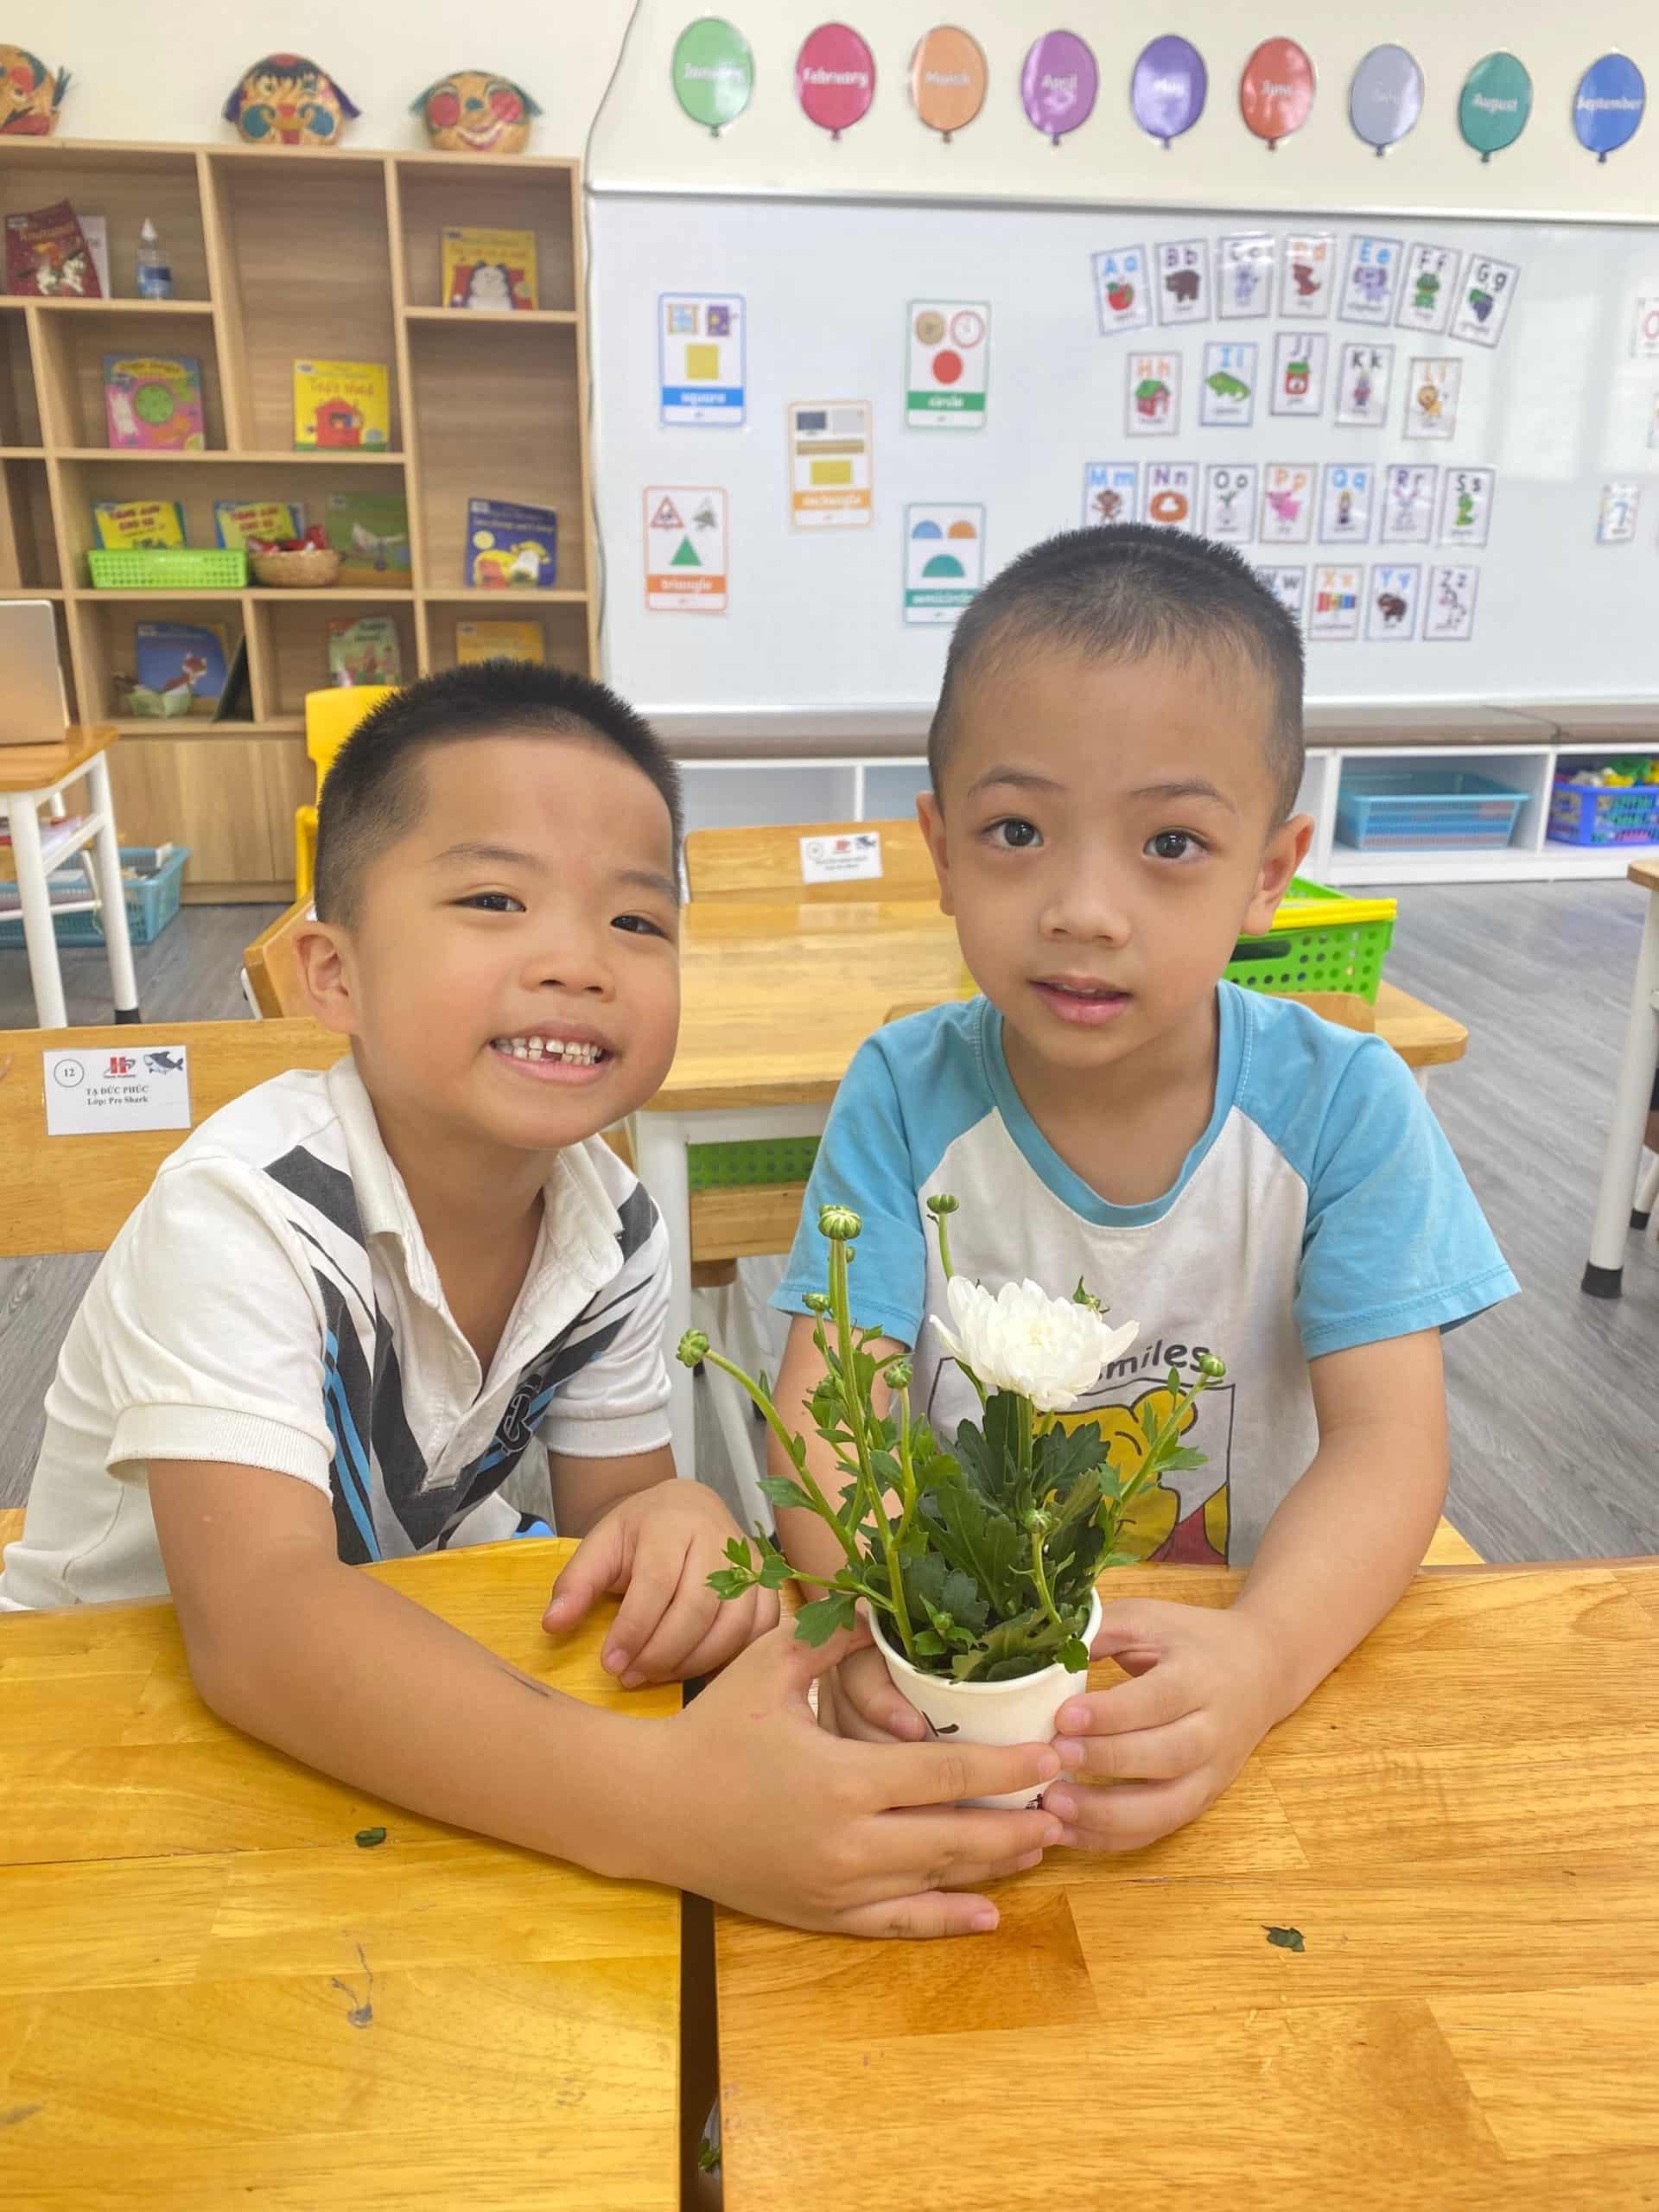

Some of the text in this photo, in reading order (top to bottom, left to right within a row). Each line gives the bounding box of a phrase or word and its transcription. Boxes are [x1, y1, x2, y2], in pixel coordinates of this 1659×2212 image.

[804, 68, 868, 88] February
[1472, 93, 1518, 114] August
[1577, 95, 1642, 113] September
[63, 1067, 76, 1078] 12
[109, 1096, 122, 1105] Pre
[124, 1095, 149, 1104] Shark
[1098, 1339, 1213, 1381] miles
